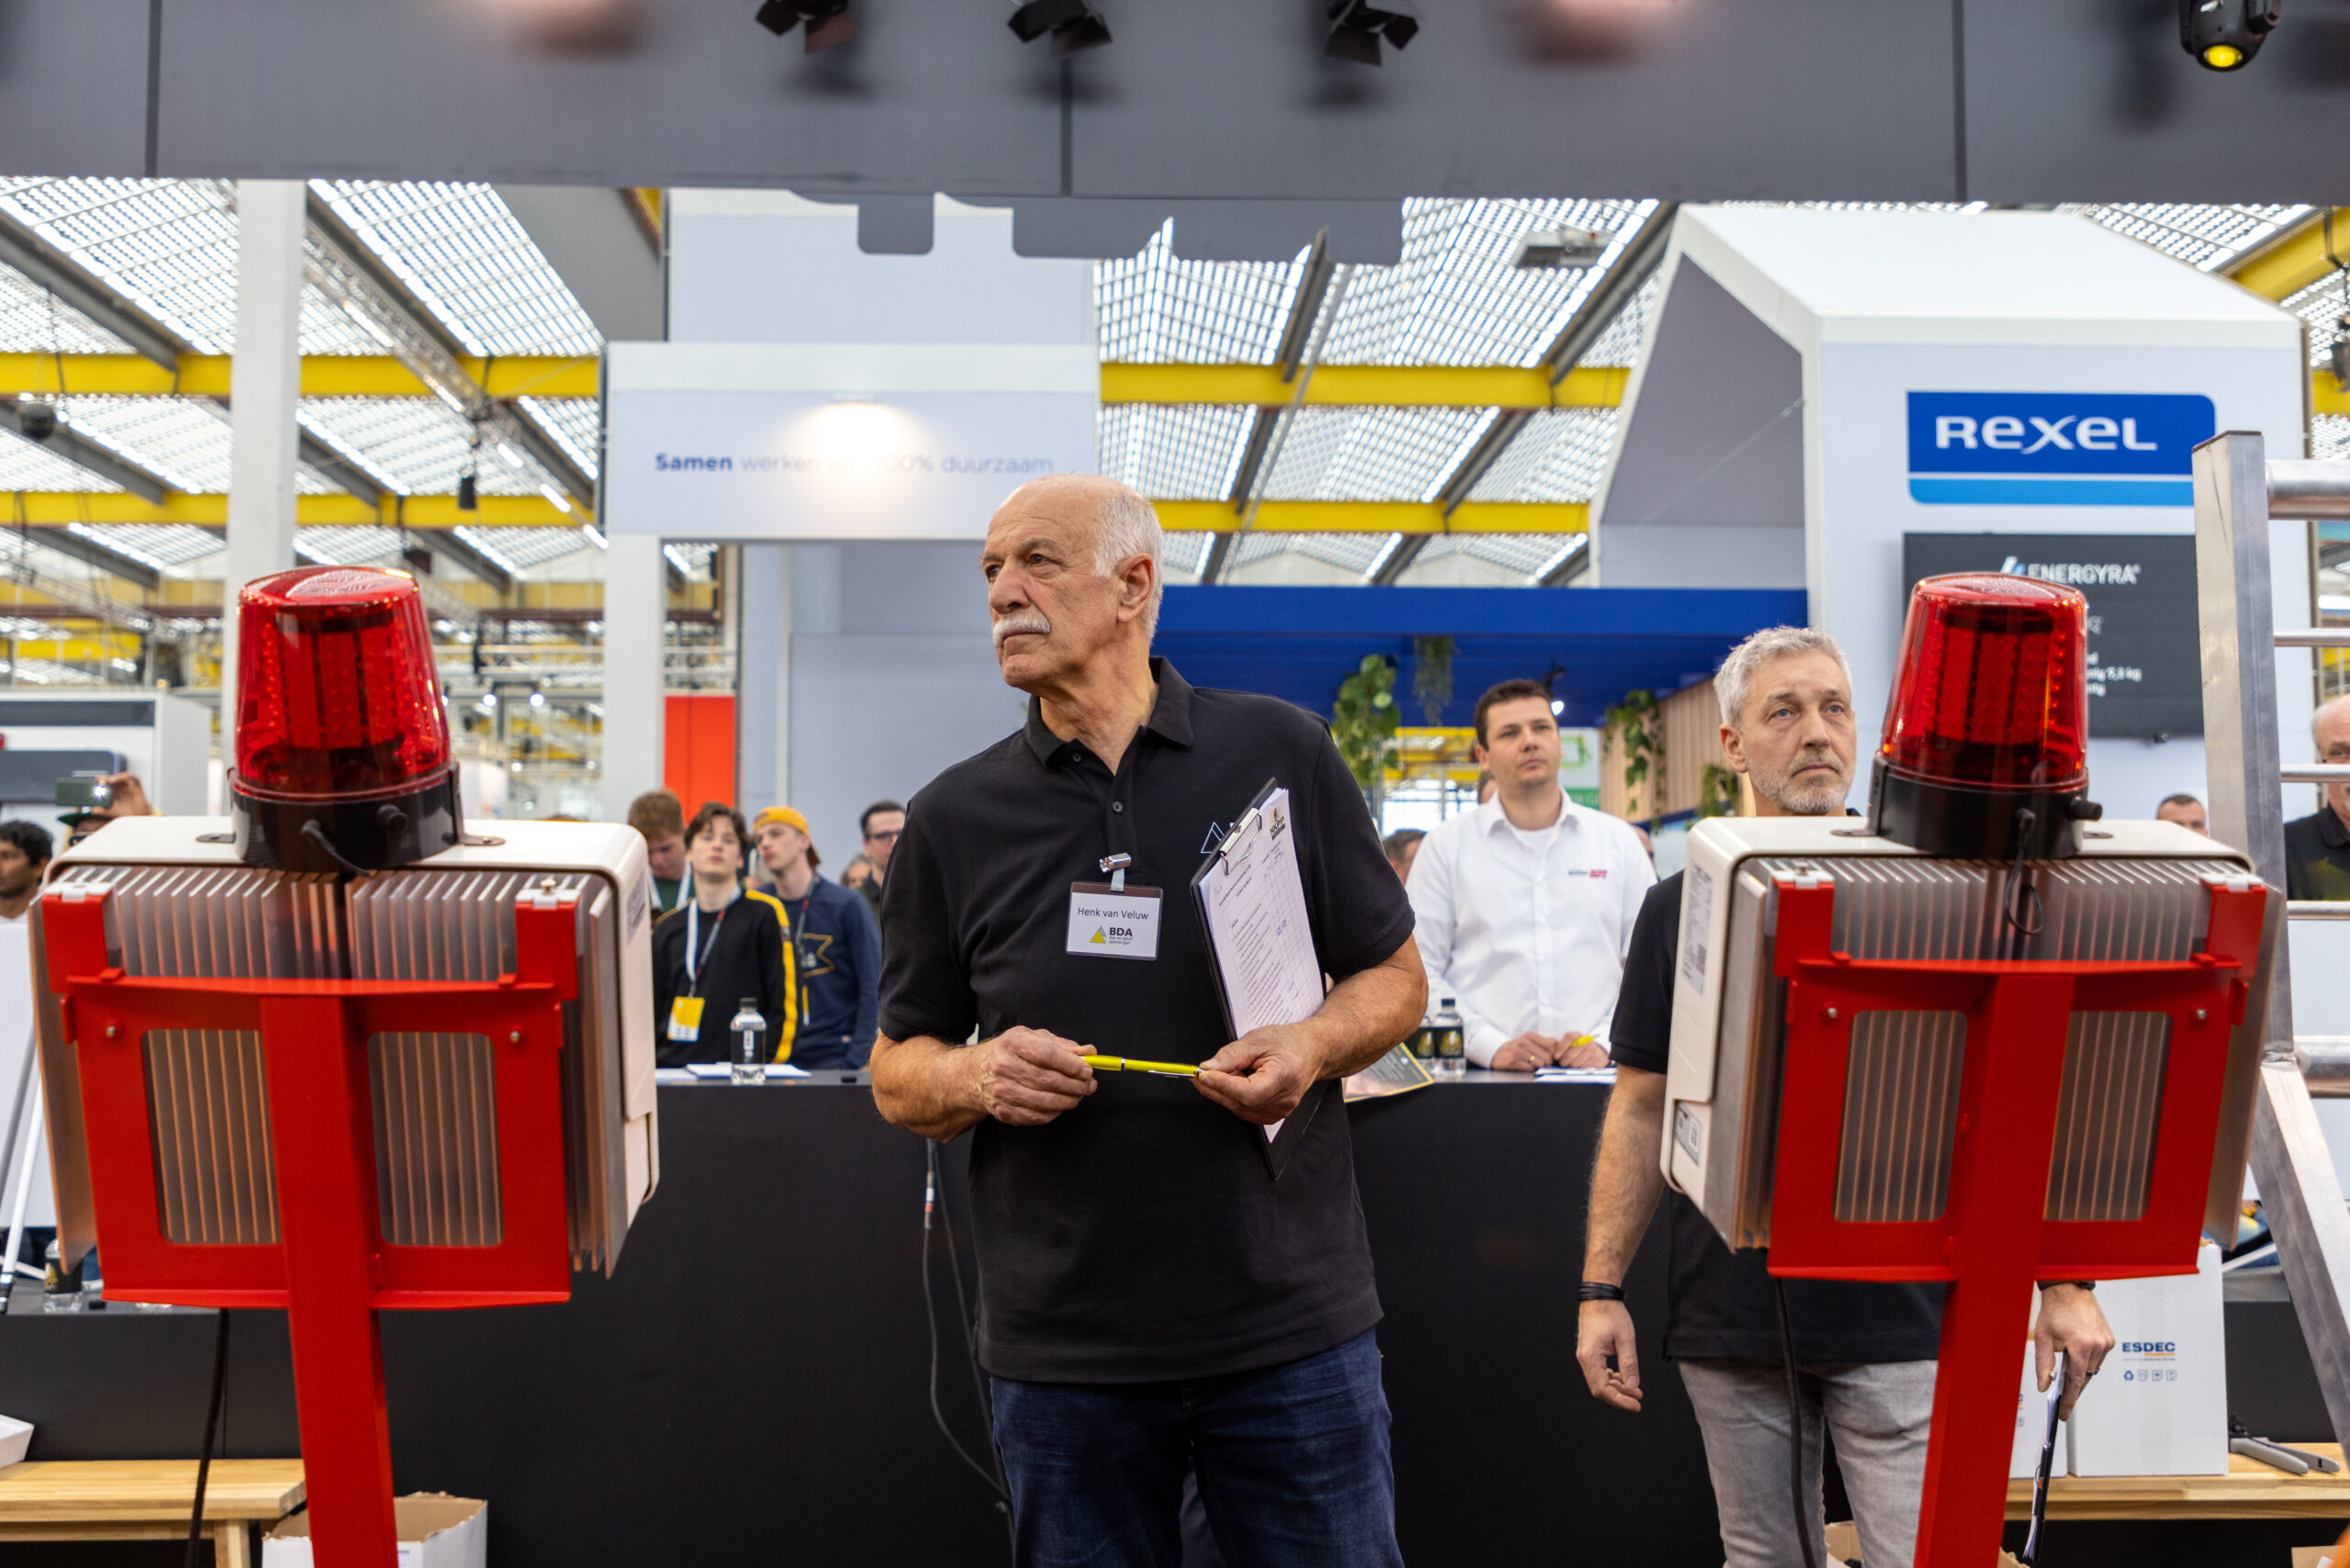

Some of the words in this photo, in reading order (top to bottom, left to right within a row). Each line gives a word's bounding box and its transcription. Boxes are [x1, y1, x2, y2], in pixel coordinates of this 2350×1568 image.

[655, 453, 733, 472] Samen
[740, 453, 821, 472] werken
[940, 453, 1054, 473] duurzaam
[1078, 907, 1101, 916] Henk
[1102, 910, 1118, 918] van
[1121, 910, 1148, 920] Veluw
[1109, 926, 1133, 936] BDA
[2122, 1342, 2176, 1352] ESDEC
